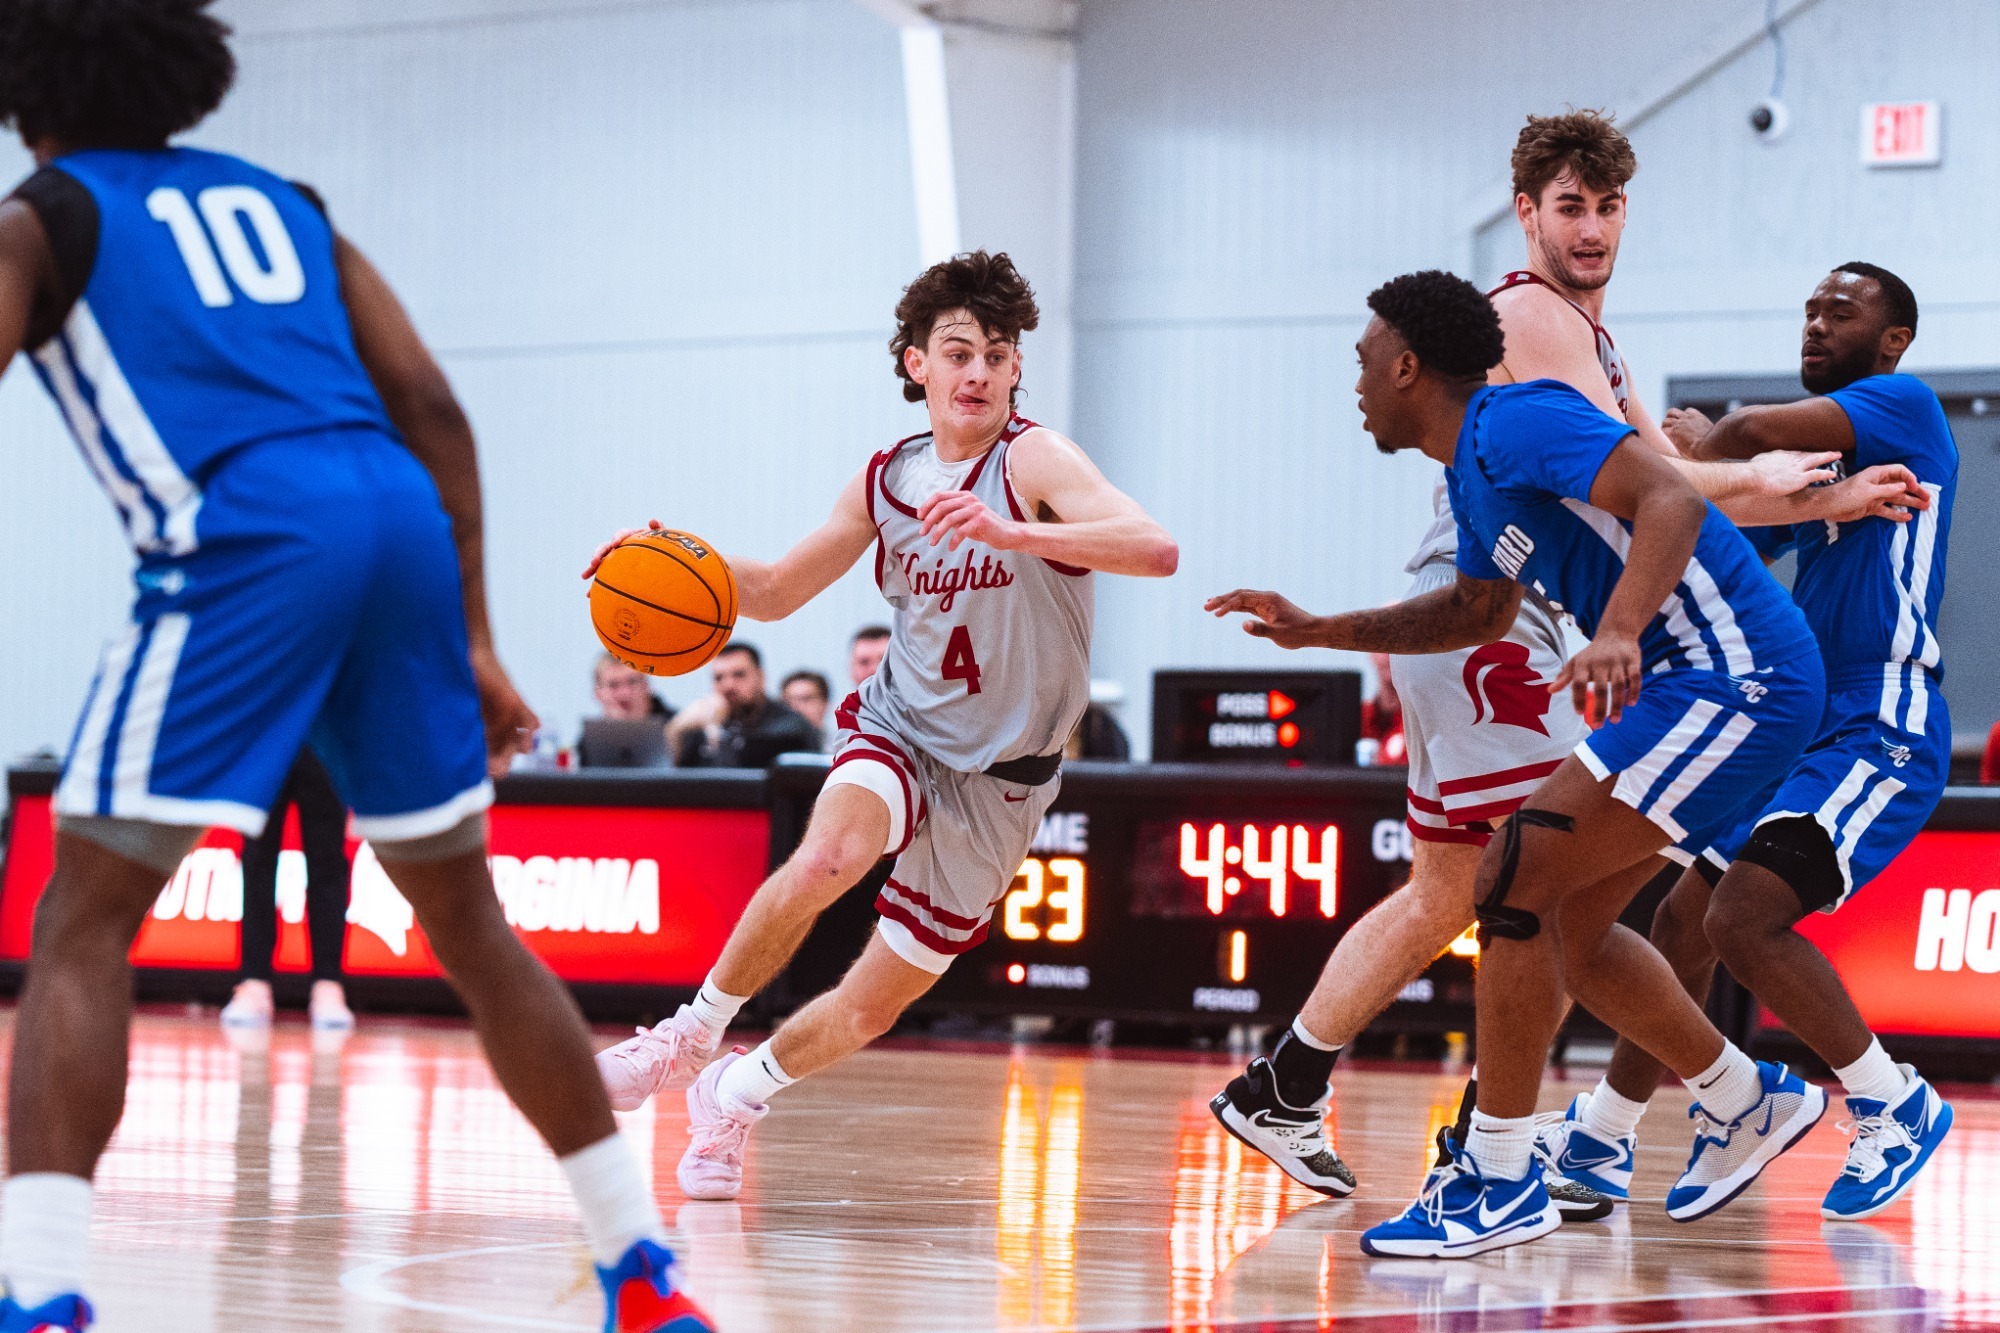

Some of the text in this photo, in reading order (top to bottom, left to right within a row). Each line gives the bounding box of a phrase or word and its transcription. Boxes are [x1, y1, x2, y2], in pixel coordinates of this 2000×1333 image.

[1874, 104, 1926, 156] EXIT
[146, 186, 305, 307] 10
[897, 549, 1014, 613] Knights
[941, 625, 981, 695] 4
[1208, 722, 1276, 748] BONUS
[1031, 812, 1089, 853] ME
[487, 855, 659, 934] RGINIA
[1005, 857, 1084, 941] 23
[1179, 821, 1338, 918] 4:44
[1229, 930, 1248, 982] 1
